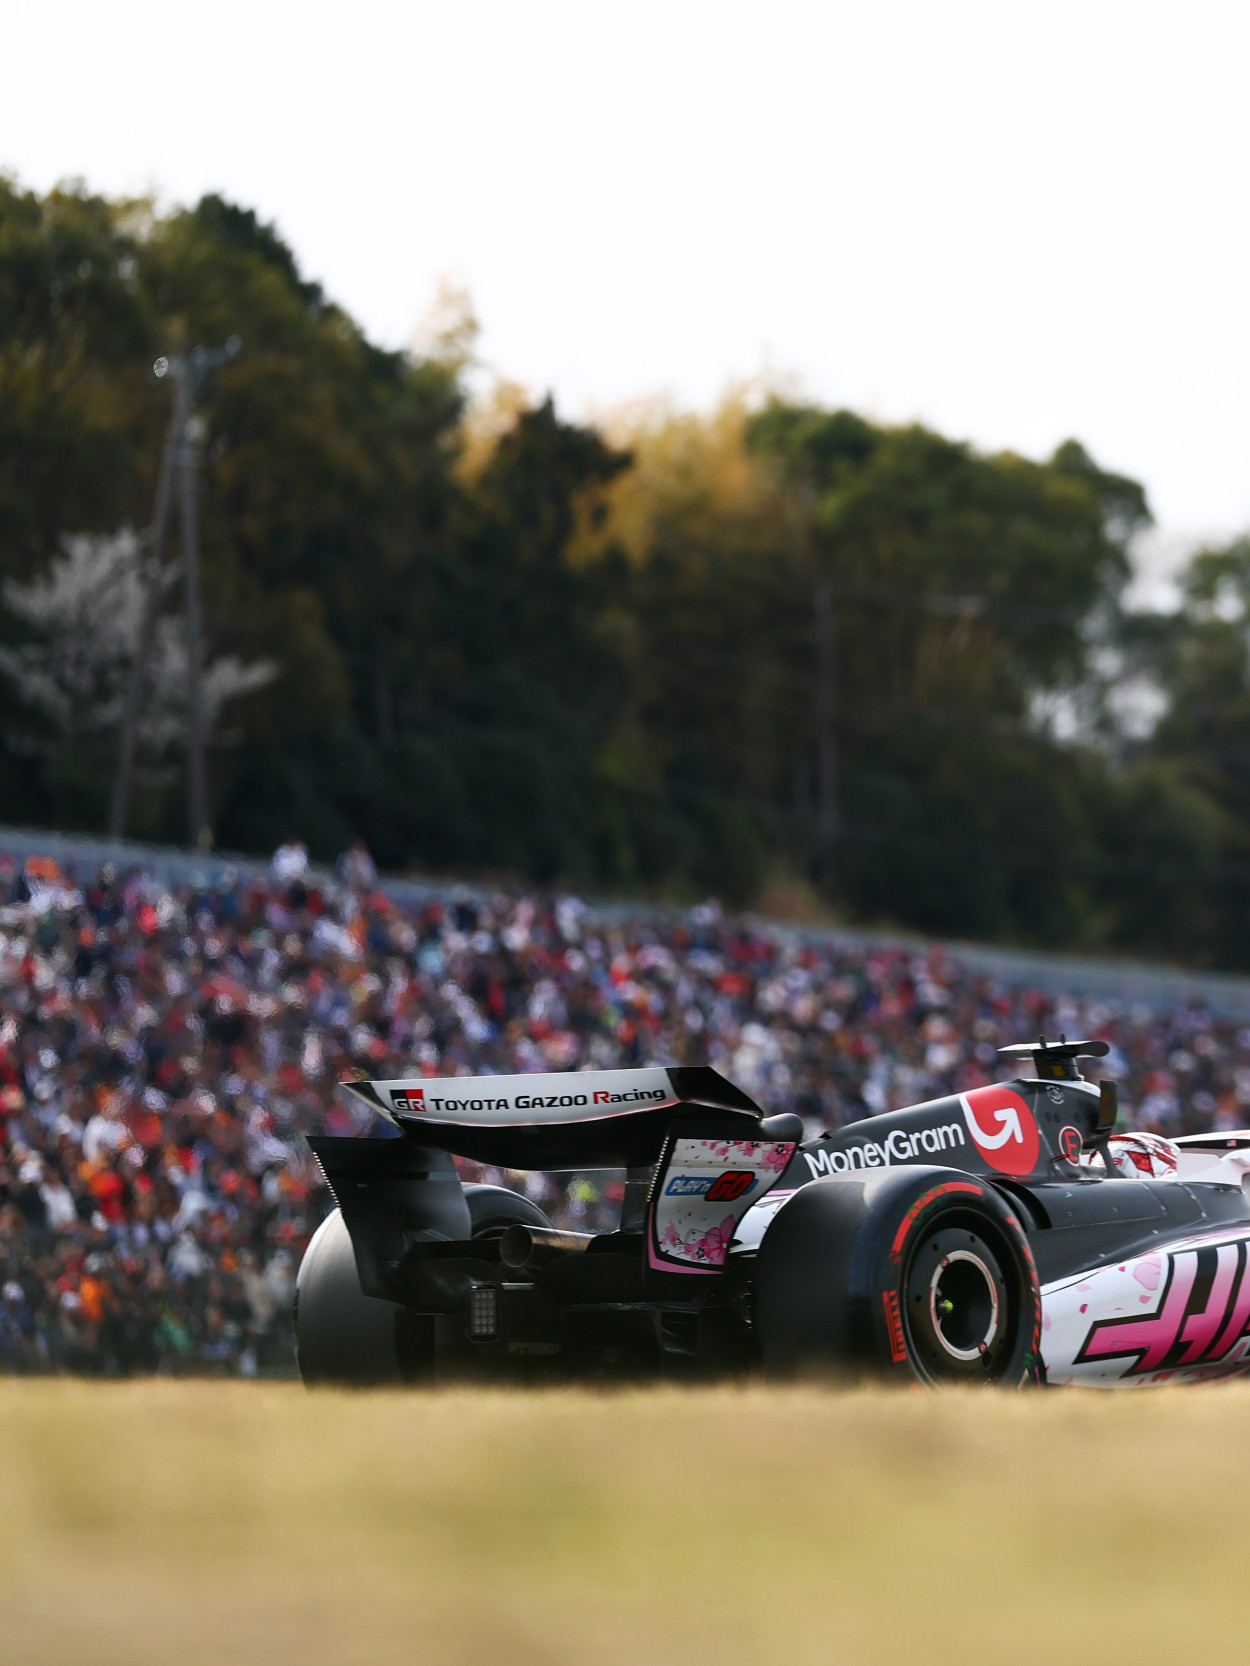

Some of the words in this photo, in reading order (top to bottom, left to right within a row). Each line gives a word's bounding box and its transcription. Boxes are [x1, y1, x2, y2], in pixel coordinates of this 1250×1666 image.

[393, 1098, 425, 1111] GR
[429, 1098, 509, 1111] TOYOTA
[514, 1095, 587, 1109] GAZOO
[592, 1088, 667, 1104] Racing
[803, 1123, 965, 1179] MoneyGram
[1063, 1131, 1079, 1162] E
[705, 1172, 755, 1201] GO
